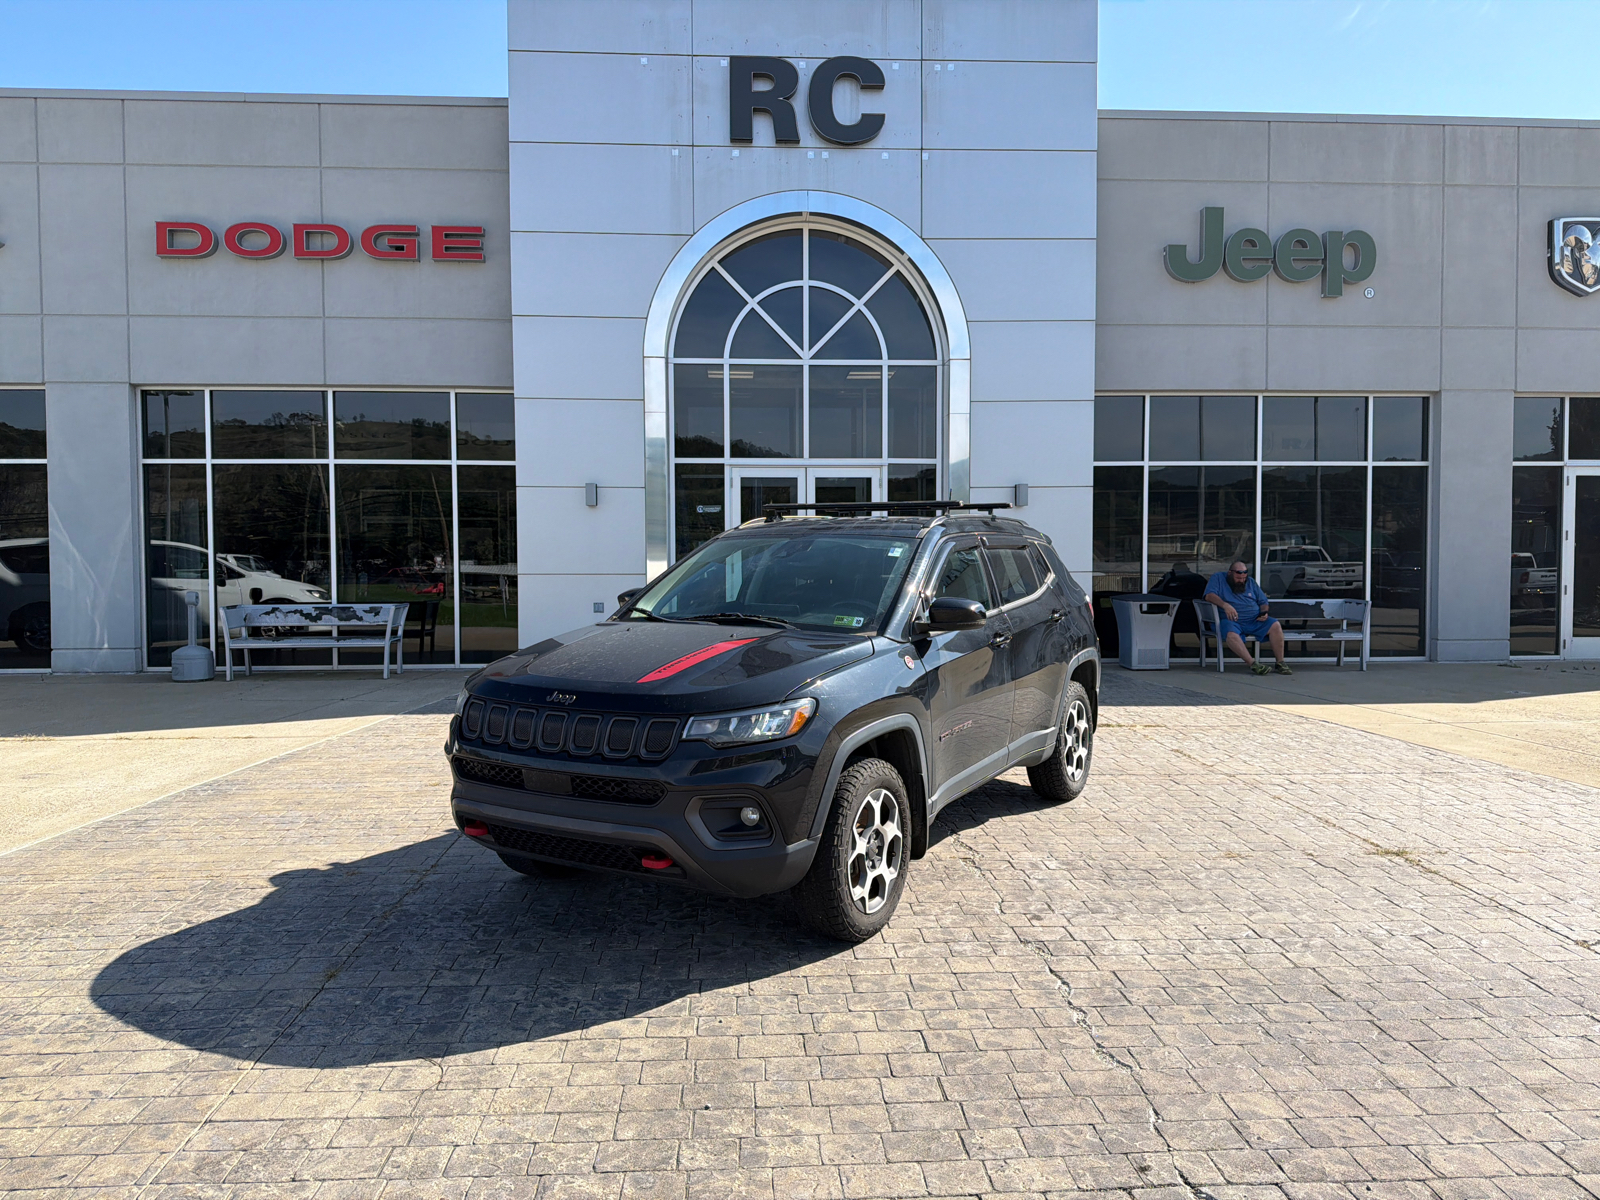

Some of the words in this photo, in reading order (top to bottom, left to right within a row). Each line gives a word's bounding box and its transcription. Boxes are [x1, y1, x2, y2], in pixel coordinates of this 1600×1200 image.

[729, 55, 886, 147] RC
[155, 221, 485, 262] DODGE
[1163, 206, 1377, 298] Jeep
[545, 691, 577, 705] Jeep
